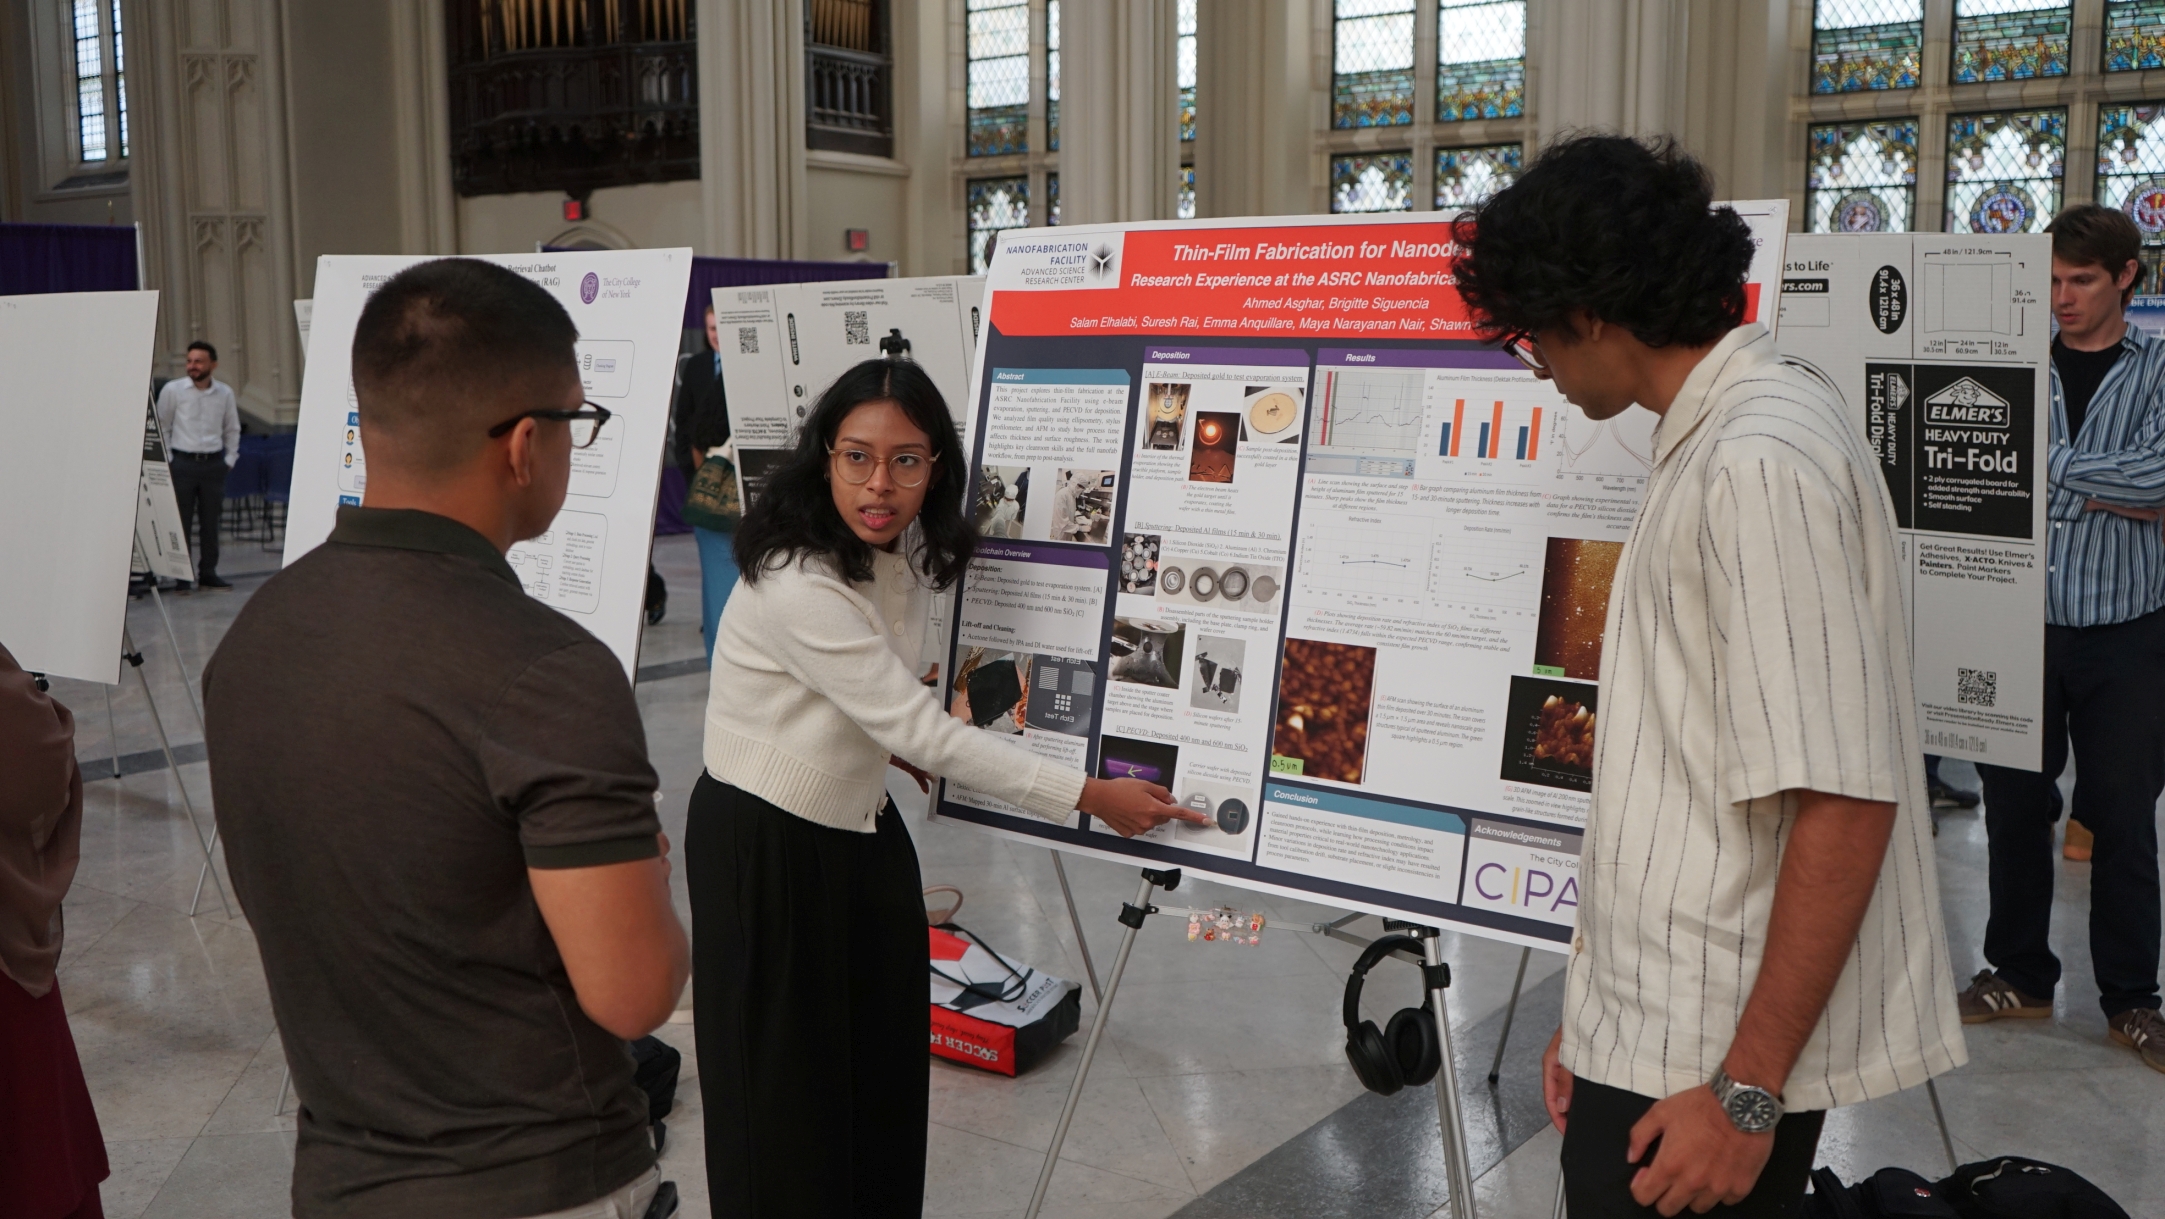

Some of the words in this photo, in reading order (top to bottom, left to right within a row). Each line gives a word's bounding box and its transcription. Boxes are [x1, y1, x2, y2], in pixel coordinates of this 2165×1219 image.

[1006, 243, 1088, 254] NANOFABRICATION
[1173, 243, 1250, 262] Thin-Film
[1255, 240, 1354, 261] Fabrication
[1359, 240, 1387, 259] for
[1050, 255, 1086, 265] FACILITY
[1794, 262, 1806, 271] to
[1808, 261, 1829, 271] Life
[534, 264, 556, 273] Chatbot
[541, 277, 560, 287] (RAG)
[603, 278, 612, 287] The
[612, 278, 622, 288] City
[623, 278, 641, 288] College
[1130, 273, 1192, 288] Research
[1195, 272, 1272, 290] Experience
[1274, 275, 1290, 287] at
[1292, 273, 1316, 287] the
[1317, 271, 1363, 286] ASRC
[1890, 279, 1901, 291] 36
[602, 290, 609, 299] of
[609, 290, 619, 298] New
[619, 290, 631, 299] York
[1243, 297, 1283, 309] Ahmed
[1284, 297, 1325, 311] Asghar,
[1328, 298, 1368, 312] Brigitte
[1371, 298, 1430, 312] Siguencia
[1890, 298, 1901, 311] 48
[1890, 311, 1900, 321] in
[1070, 317, 1098, 329] Salam
[1100, 317, 1138, 330] Elhalabi,
[1141, 316, 1181, 329] Suresh
[1182, 317, 1200, 330] Rai,
[1203, 317, 1237, 329] Emma
[1239, 317, 1296, 332] Anquillare,
[1299, 318, 1330, 332] Maya
[1332, 317, 1397, 334] Narayanan
[1399, 318, 1426, 332] Nair,
[1429, 318, 1472, 331] Shawn
[1152, 351, 1190, 360] Deposition
[1345, 353, 1376, 362] Results
[1182, 372, 1210, 380] Deposited
[1212, 373, 1225, 381] gold
[1871, 372, 1884, 423] Tri-Fold
[1931, 406, 2003, 423] ELMER'S
[1888, 412, 1896, 441] HEAVY
[1925, 429, 1970, 444] HEAVY
[1973, 432, 2010, 445] DUTY
[1871, 426, 1884, 464] Displ
[1888, 442, 1896, 465] DUTY
[1924, 446, 2018, 473] Tri-Fold
[1934, 476, 1944, 484] ply
[1946, 477, 1984, 487] corrugated
[1986, 479, 2007, 488] board
[1928, 493, 1954, 501] Smooth
[1955, 495, 1982, 504] surface
[1951, 485, 1980, 495] strength
[1996, 489, 2030, 499] durability
[1942, 503, 1972, 512] standing
[1175, 525, 1202, 534] Deposited
[1005, 549, 1031, 558] Overview
[1956, 546, 1987, 555] Results!
[2005, 550, 2034, 560] Elmer's
[1920, 552, 1961, 562] Adhesives,
[1998, 558, 2025, 568] Knives
[969, 564, 1003, 572] Deposition:
[1957, 563, 1976, 572] Paint
[1978, 565, 2011, 575] Markers
[1929, 569, 1966, 579] Complete
[1967, 573, 1985, 581] Your
[1987, 574, 2017, 585] Project.
[962, 620, 982, 629] Lift-off
[994, 624, 1016, 634] Cleaning:
[1272, 760, 1285, 771] 0.5
[1273, 789, 1319, 805] Conclusion
[1474, 825, 1562, 847] Acknowledgements
[1530, 854, 1545, 863] The
[1547, 857, 1564, 867] City
[1565, 860, 1579, 869] Col
[1475, 862, 1579, 912] CIPA
[946, 1036, 998, 1062] SOCCER
